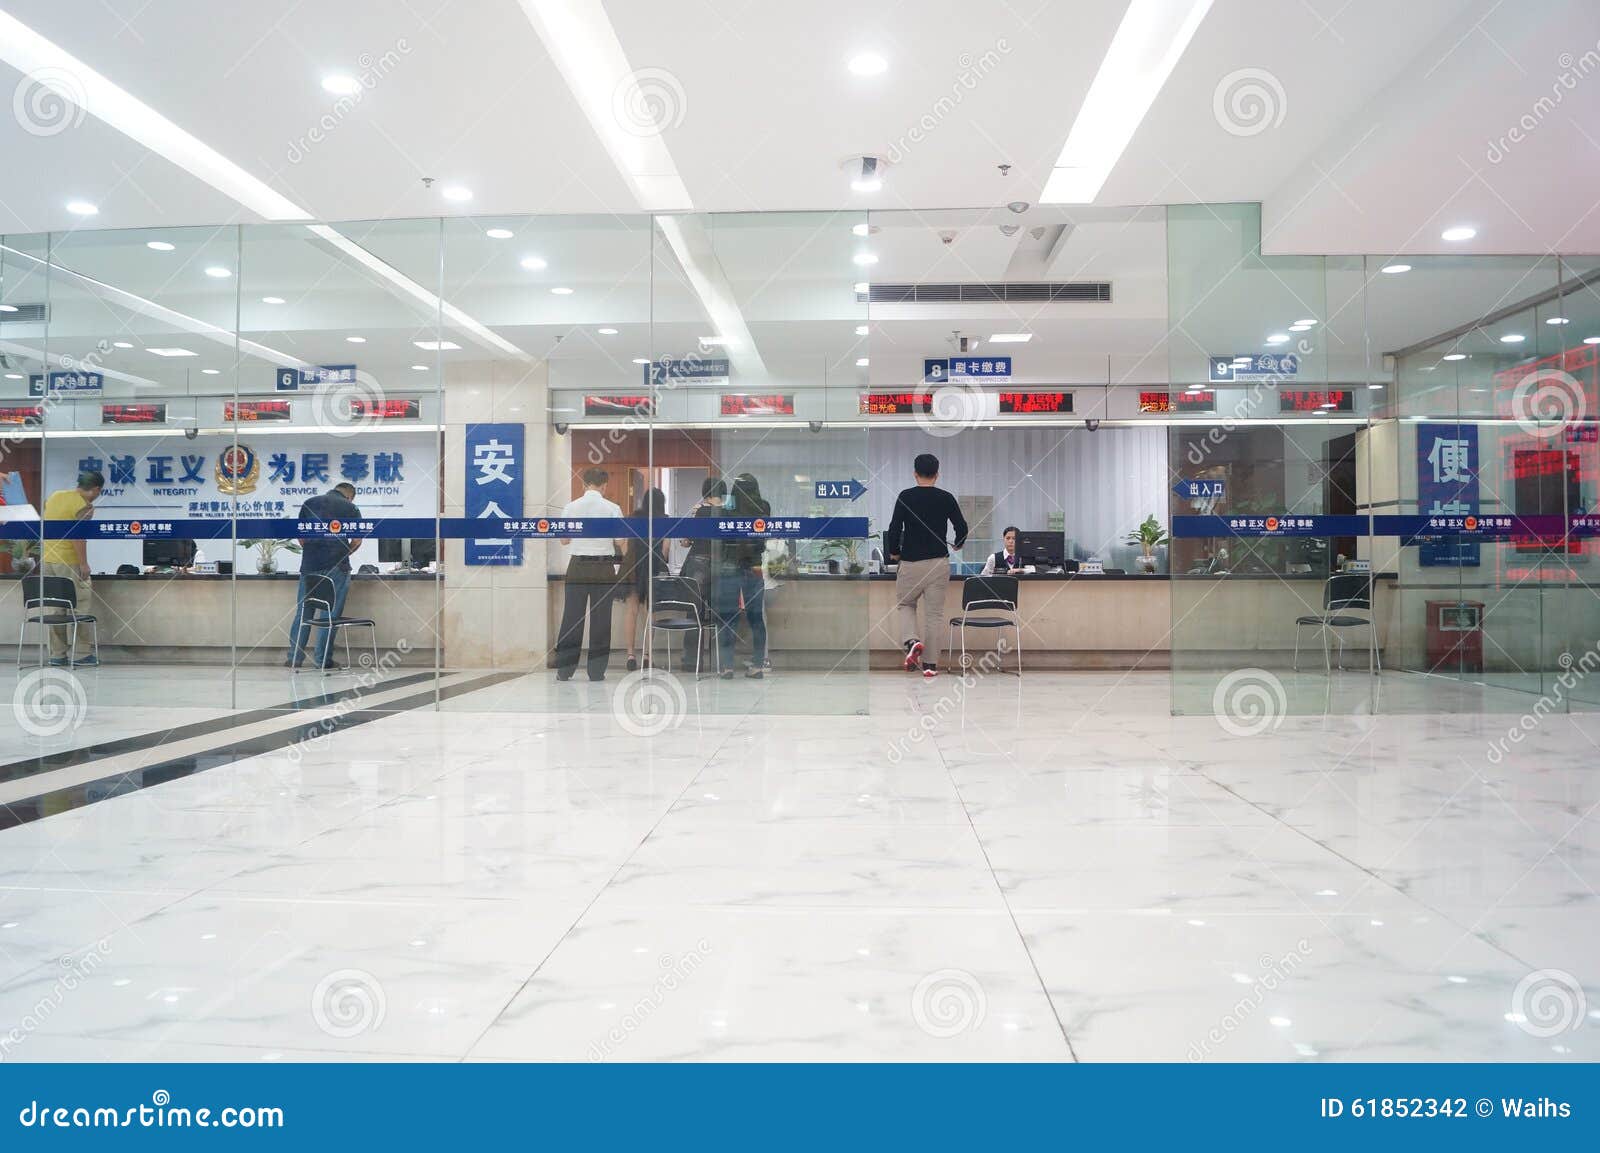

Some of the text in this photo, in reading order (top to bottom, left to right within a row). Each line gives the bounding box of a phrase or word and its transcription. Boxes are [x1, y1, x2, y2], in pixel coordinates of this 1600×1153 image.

[931, 364, 942, 377] 8
[955, 362, 1006, 373] 刷卡缴费
[1217, 363, 1227, 375] 9
[35, 379, 44, 391] 5
[282, 373, 292, 386] 6
[146, 455, 206, 484] 正义
[268, 453, 330, 484] 为民
[153, 488, 199, 496] INTEGRITY
[280, 487, 318, 495] SERVICE
[357, 486, 400, 495] DICATION
[818, 484, 850, 496] 出入口
[1190, 482, 1222, 495] 出入口
